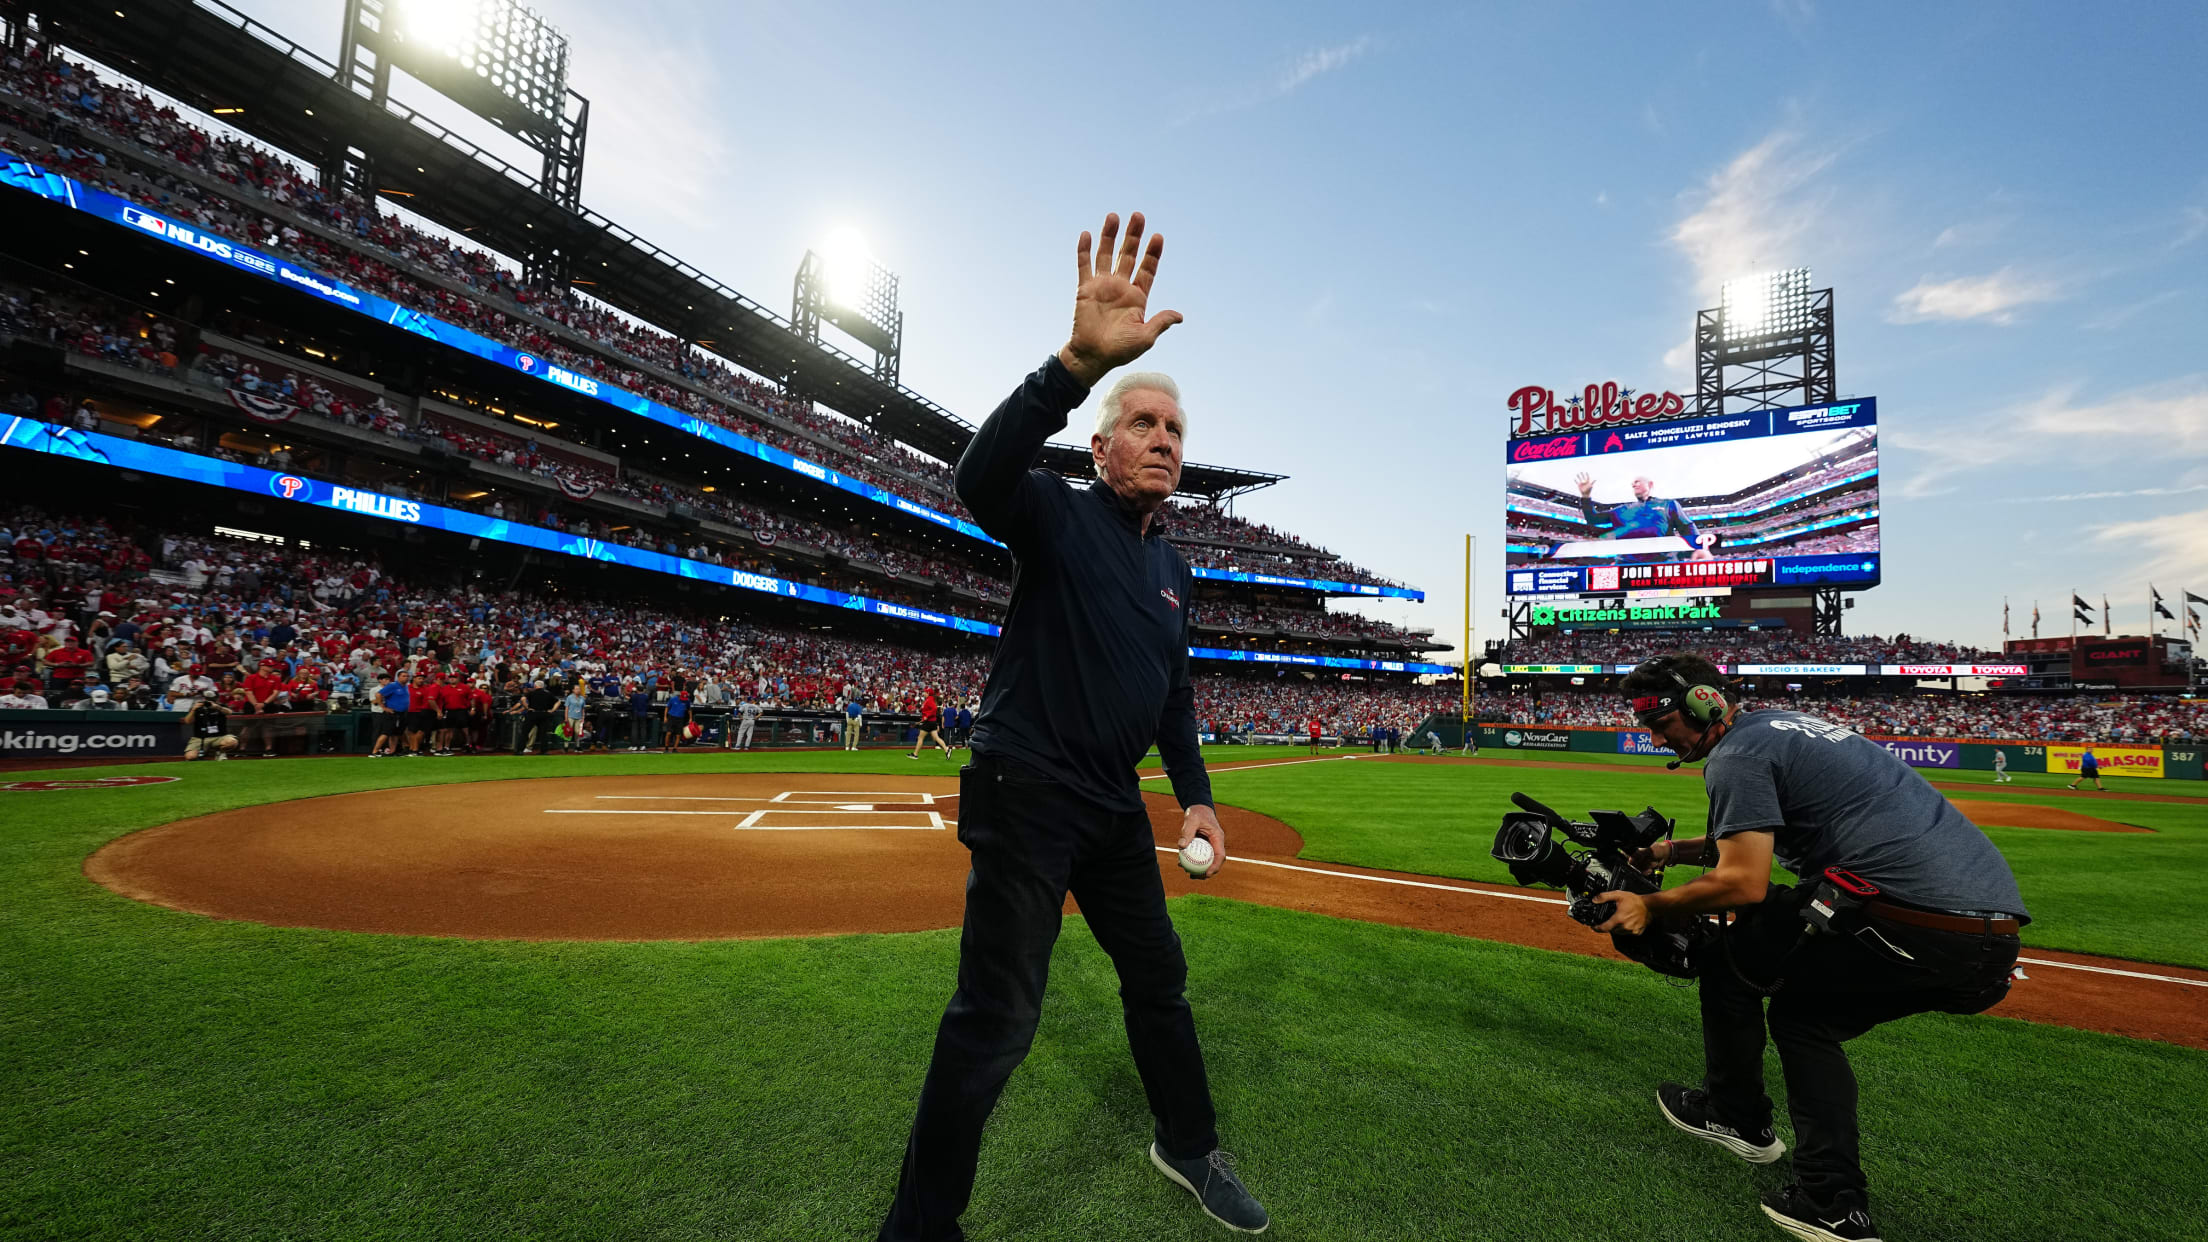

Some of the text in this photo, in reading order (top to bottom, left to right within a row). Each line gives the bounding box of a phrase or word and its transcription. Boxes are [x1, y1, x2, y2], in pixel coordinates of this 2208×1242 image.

[168, 224, 275, 273] NLDS 2025
[281, 267, 359, 304] Booking.com
[548, 365, 598, 395] PHILLIES
[1507, 381, 1684, 434] Phillies
[1788, 404, 1861, 421] ESPN BET
[1796, 415, 1852, 425] SPORTSBOOK
[1624, 431, 1648, 440] SALTZ
[1706, 419, 1751, 430] BENDESKY
[1648, 430, 1726, 443] INJURY LAWYERS
[1513, 436, 1580, 461] Coca-Cola
[332, 486, 421, 522] PHILLIES
[1622, 561, 1767, 579] JOIN THE LIGHTSHOW
[1782, 562, 1859, 575] Independence
[733, 571, 778, 592] DODGERS
[1558, 603, 1721, 621] Citizens Bank Park
[2089, 650, 2142, 660] GIANT
[1542, 665, 1560, 673] UKG
[1574, 665, 1594, 673] UKG
[1903, 666, 1948, 674] TOYOTA
[1975, 666, 2025, 674] TOYOTA
[1694, 688, 1709, 701] 6
[1660, 697, 1671, 706] P
[1522, 732, 1569, 742] NovaCare
[1637, 743, 1676, 754] WILLIA
[1885, 742, 1953, 765] finity
[2024, 747, 2043, 756] 374
[2096, 755, 2160, 767] MASON
[2171, 752, 2194, 761] 387
[1705, 1120, 1741, 1137] HOKA
